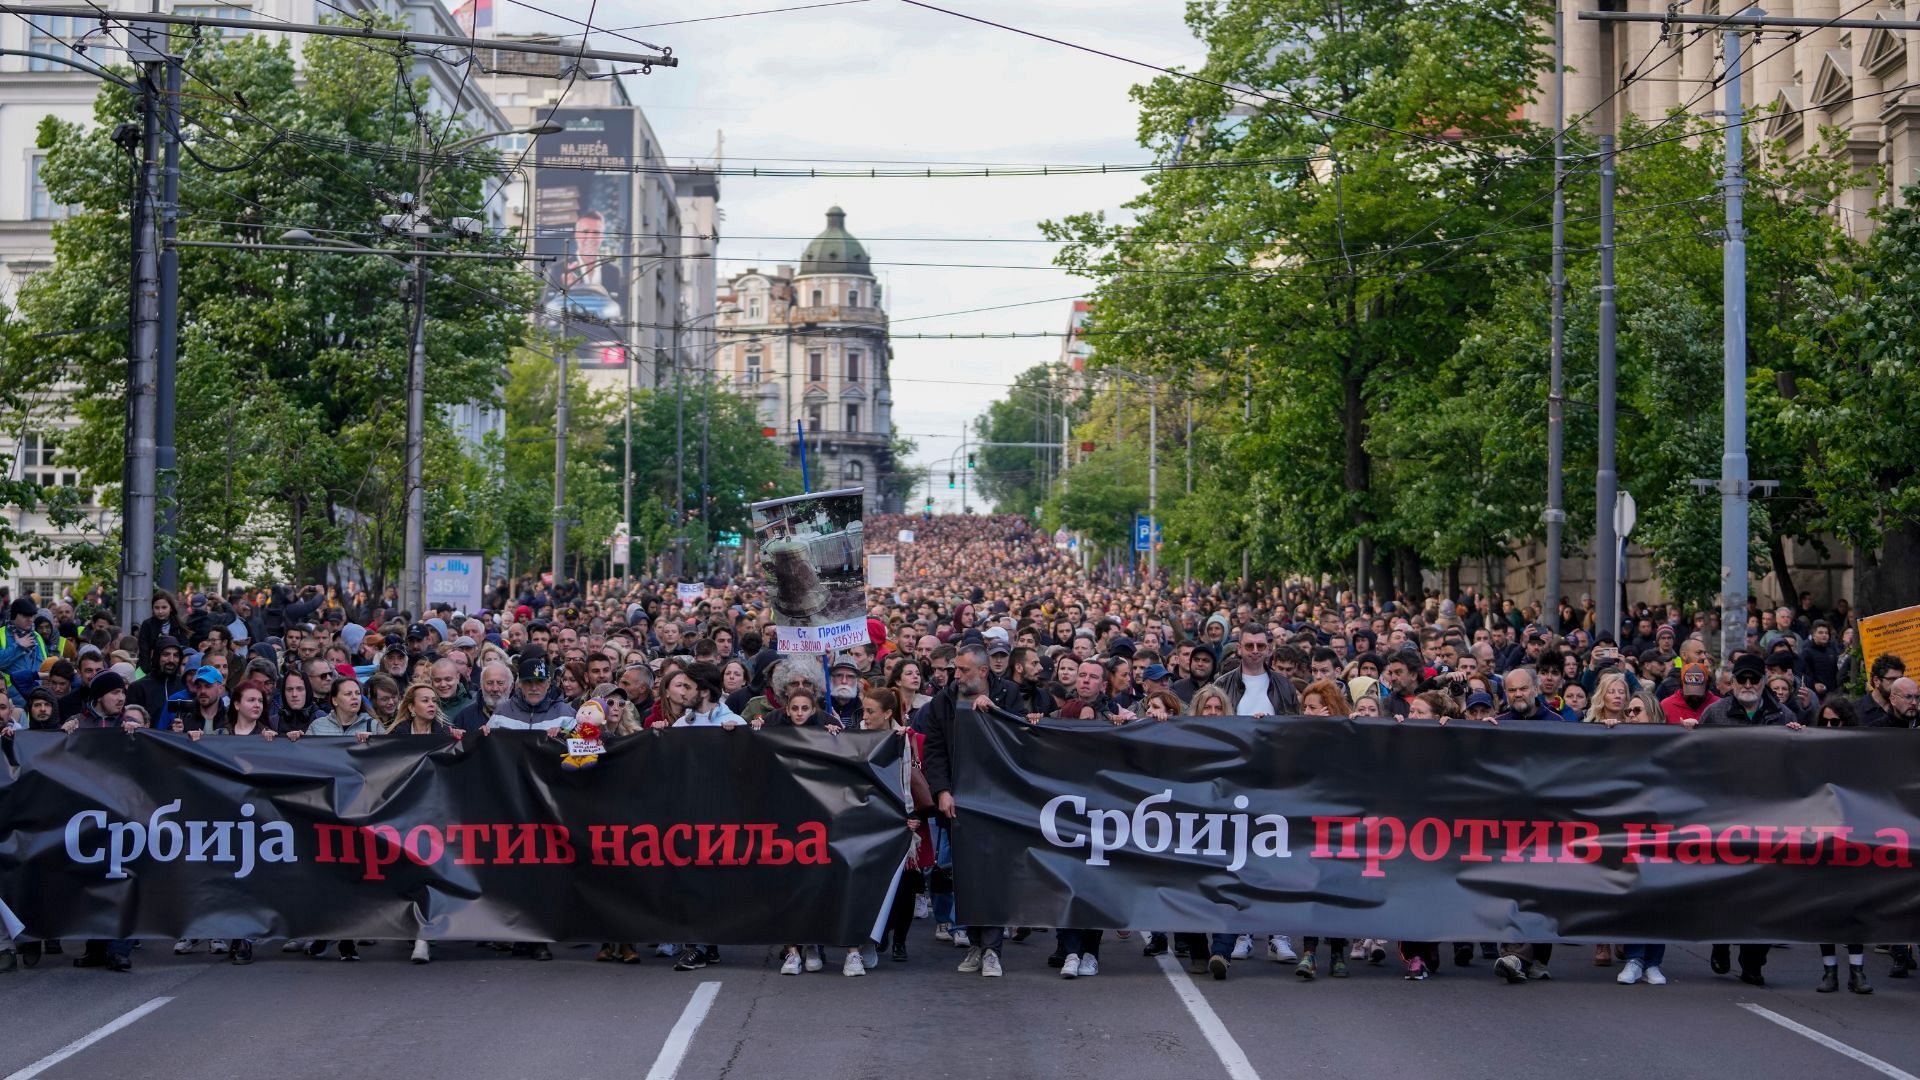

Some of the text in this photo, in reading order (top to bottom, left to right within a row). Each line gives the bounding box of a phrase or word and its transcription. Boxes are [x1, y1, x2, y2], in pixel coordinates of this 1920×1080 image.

[560, 140, 609, 156] NAJVEĆA
[1140, 527, 1149, 539] P
[447, 559, 469, 576] lilly
[433, 579, 469, 593] 35%
[64, 799, 832, 880] Србија против насиља
[1039, 789, 1912, 877] Србија против насиља
